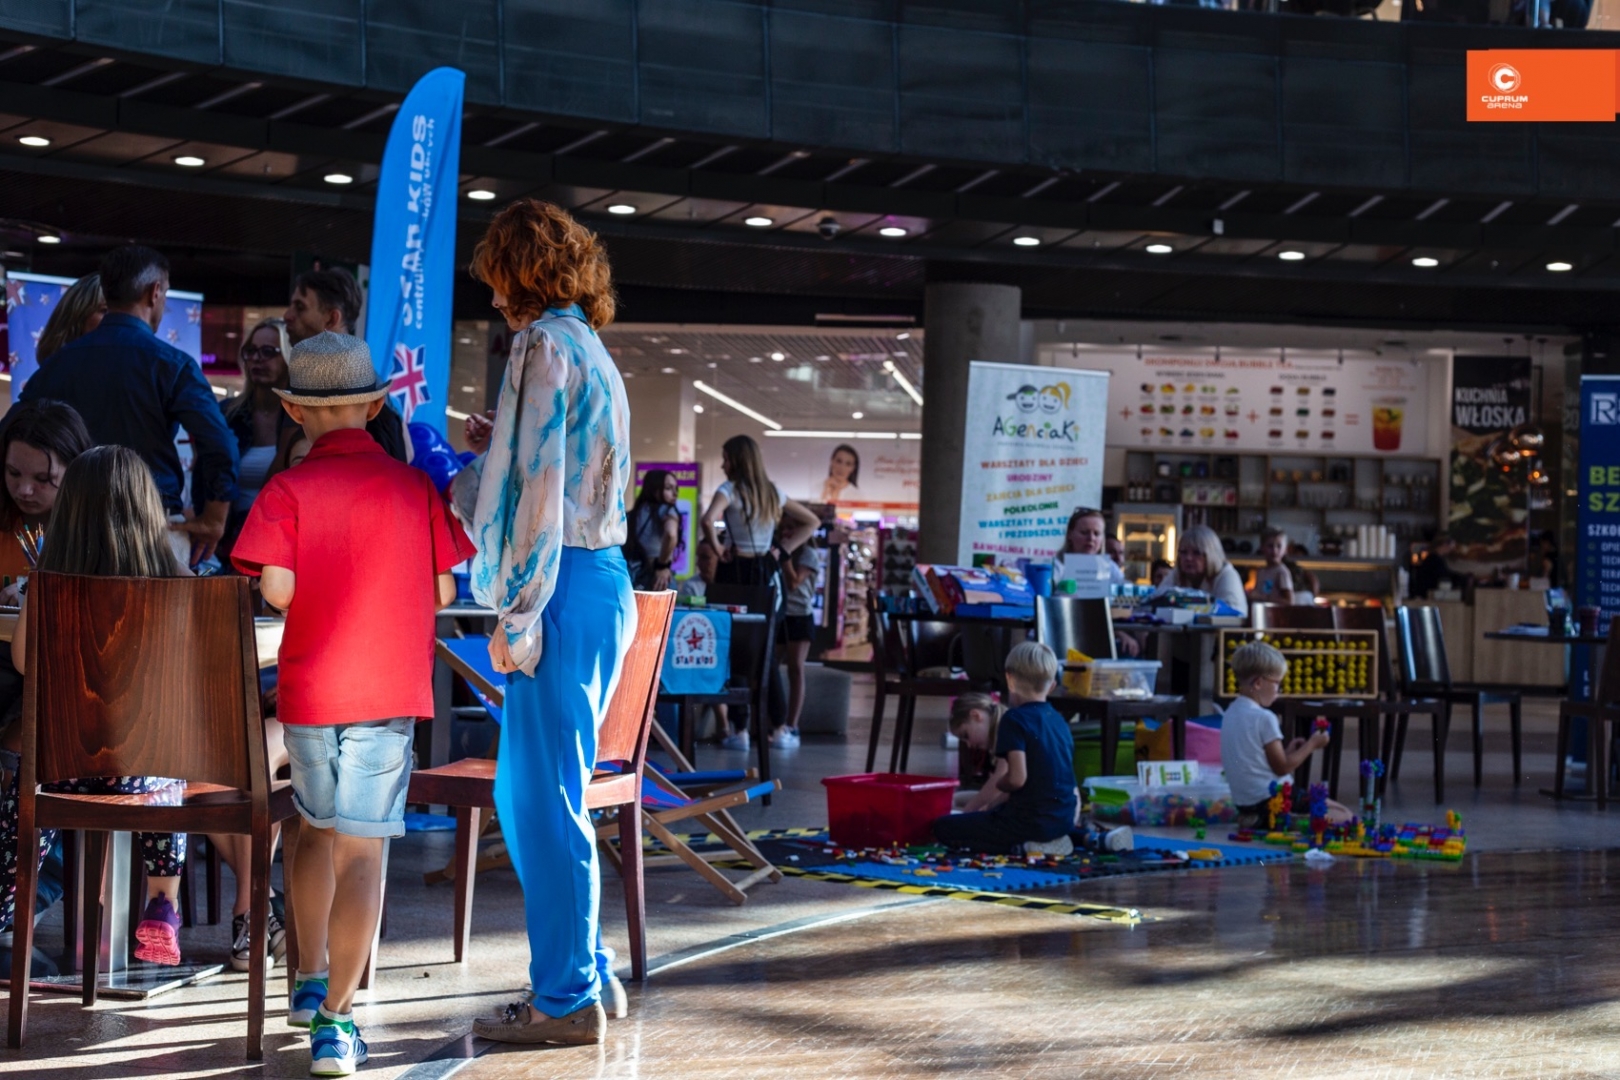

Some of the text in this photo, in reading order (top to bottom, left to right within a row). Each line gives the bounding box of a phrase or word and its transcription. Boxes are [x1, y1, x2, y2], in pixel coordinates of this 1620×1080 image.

[407, 114, 427, 213] KIDS
[1455, 387, 1508, 403] KUCHNIA
[1455, 405, 1526, 427] WŁOSKA
[981, 457, 1089, 469] WARSZTATY DLA DZIECI
[978, 515, 1070, 528] WARSZTATY DLA SZ
[676, 655, 714, 665] STAR KIDS
